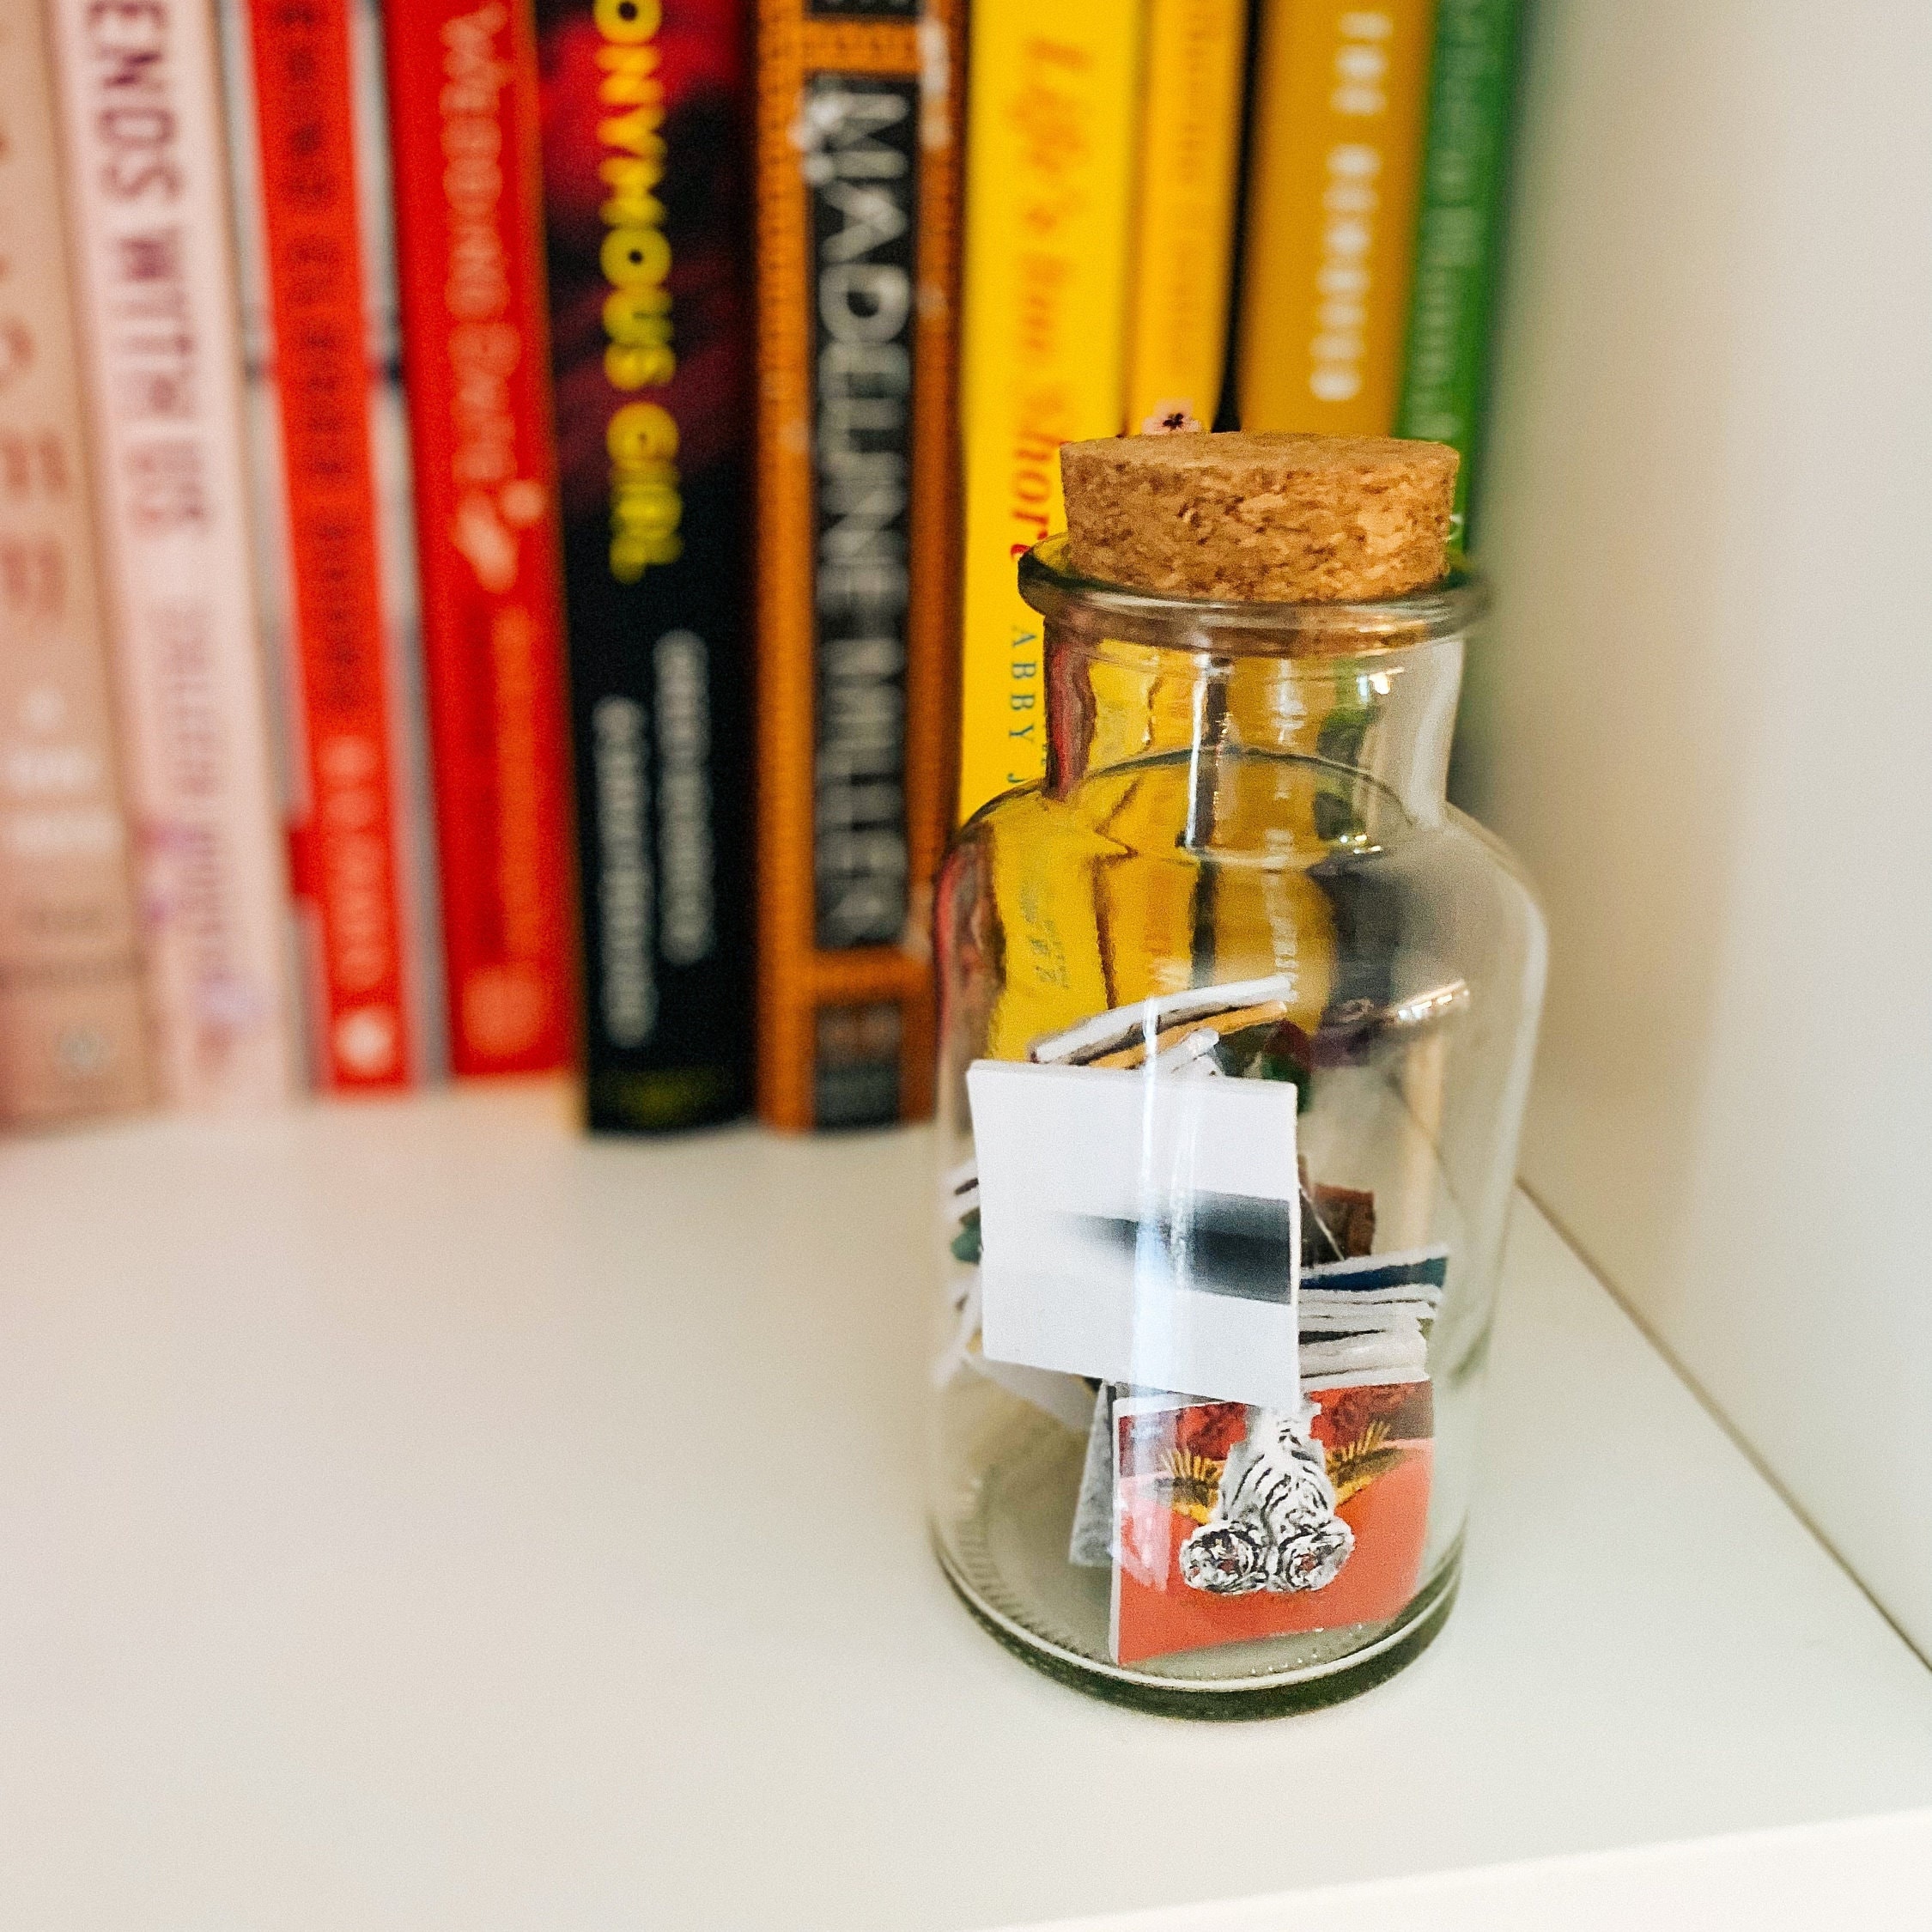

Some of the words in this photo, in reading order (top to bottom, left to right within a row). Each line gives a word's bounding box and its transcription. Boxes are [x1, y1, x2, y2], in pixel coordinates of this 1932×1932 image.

[86, 0, 187, 201] ENDS
[592, 0, 675, 391] ONYMOUS
[814, 86, 910, 615] MADELINE
[605, 402, 683, 584] GIRL
[814, 634, 908, 945] MILLER
[1007, 625, 1038, 745] ABBY
